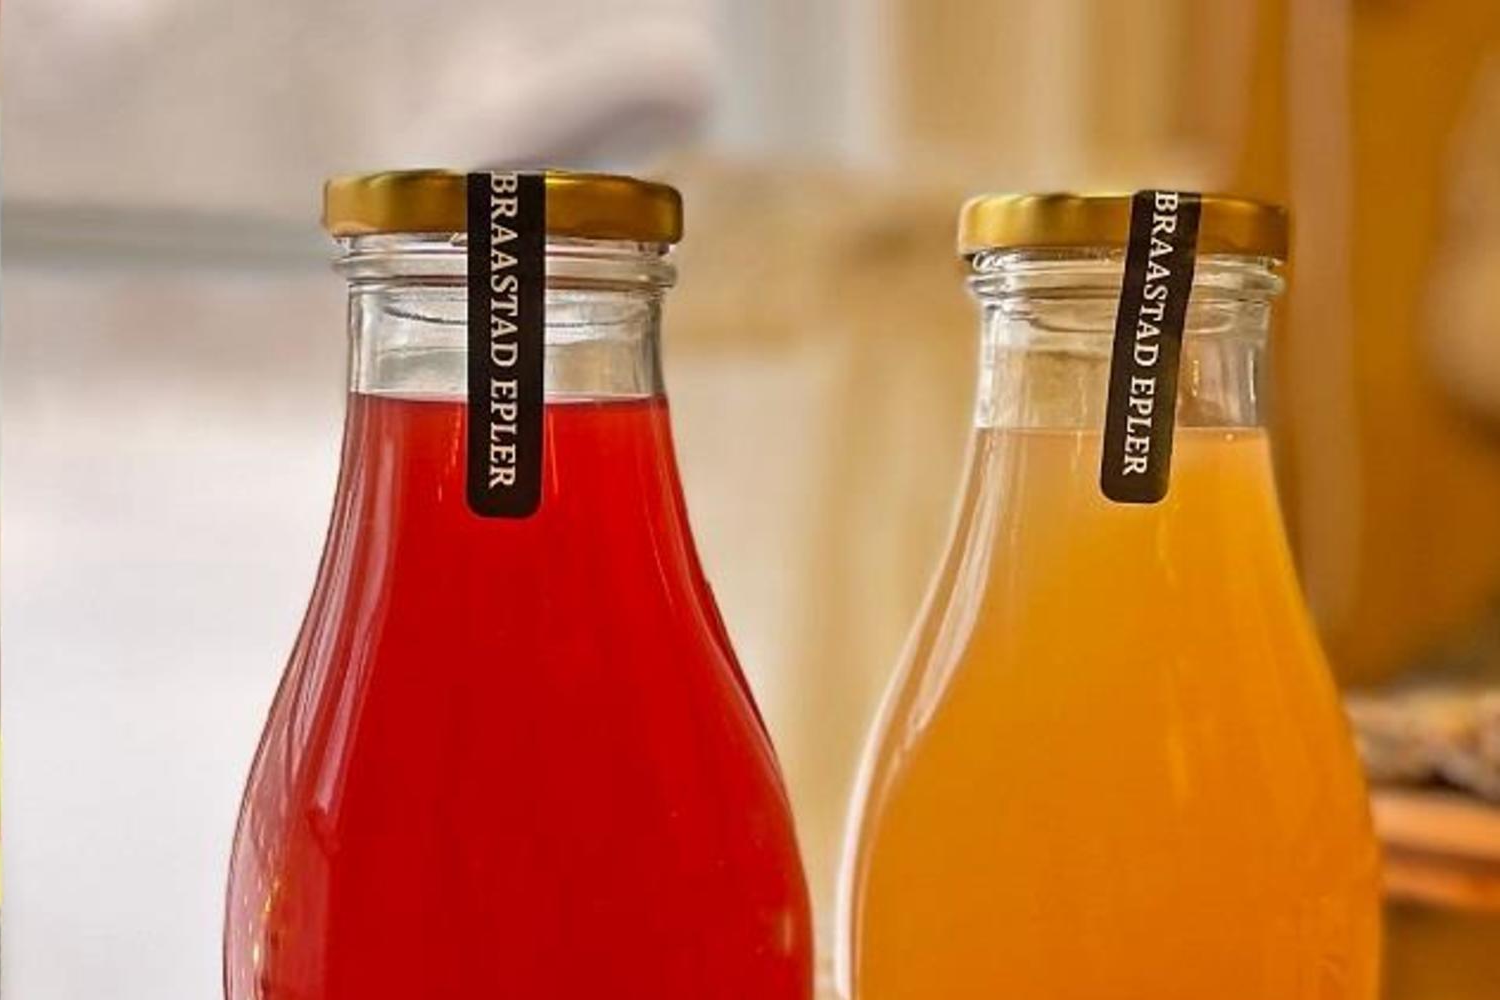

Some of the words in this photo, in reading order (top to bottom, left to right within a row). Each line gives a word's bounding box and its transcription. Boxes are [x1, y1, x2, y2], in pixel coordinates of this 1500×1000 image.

[490, 170, 518, 368] BRAASTAD
[1133, 191, 1180, 368] BRAASTAD
[488, 378, 518, 490] EPLER
[1122, 376, 1156, 476] EPLER
